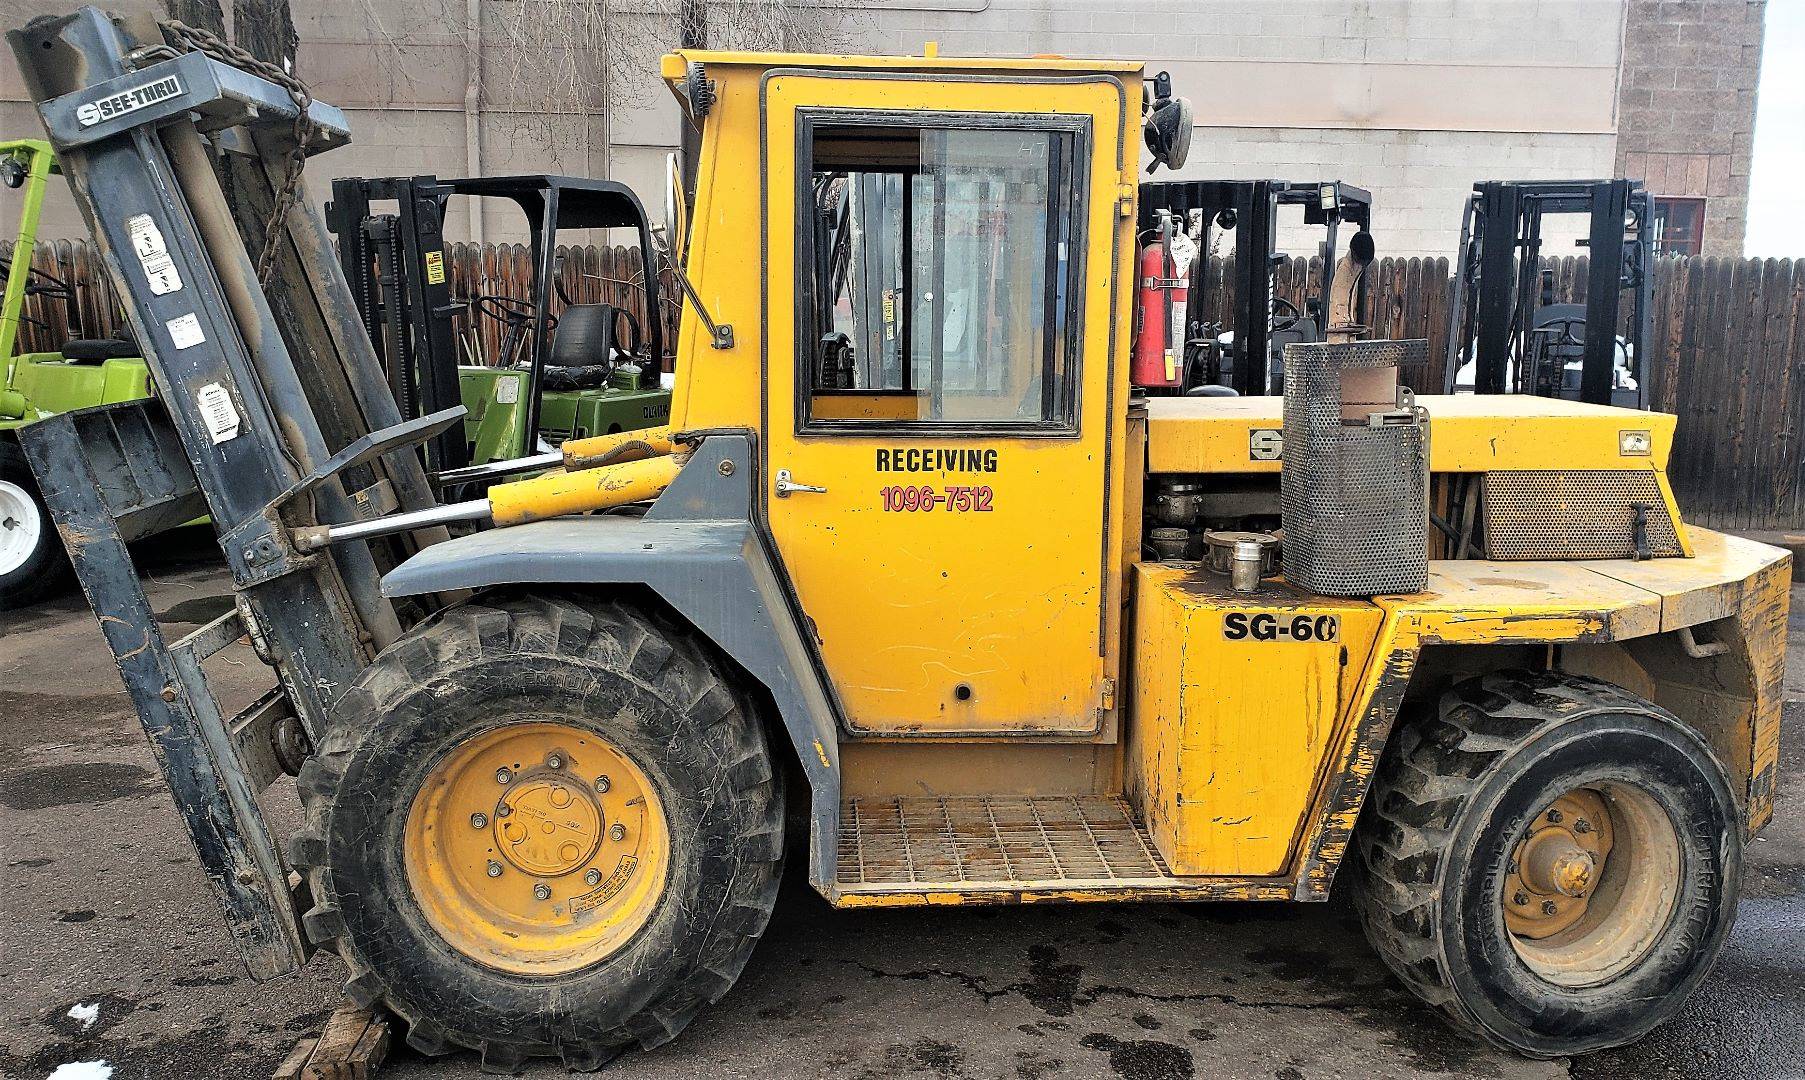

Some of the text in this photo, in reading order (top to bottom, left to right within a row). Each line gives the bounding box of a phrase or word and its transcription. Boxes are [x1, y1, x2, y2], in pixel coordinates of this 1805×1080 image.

[101, 77, 179, 117] SEE-THRU
[876, 448, 998, 473] RECEIVING
[880, 485, 994, 513] 1096-7512
[1223, 612, 1337, 642] SG-60
